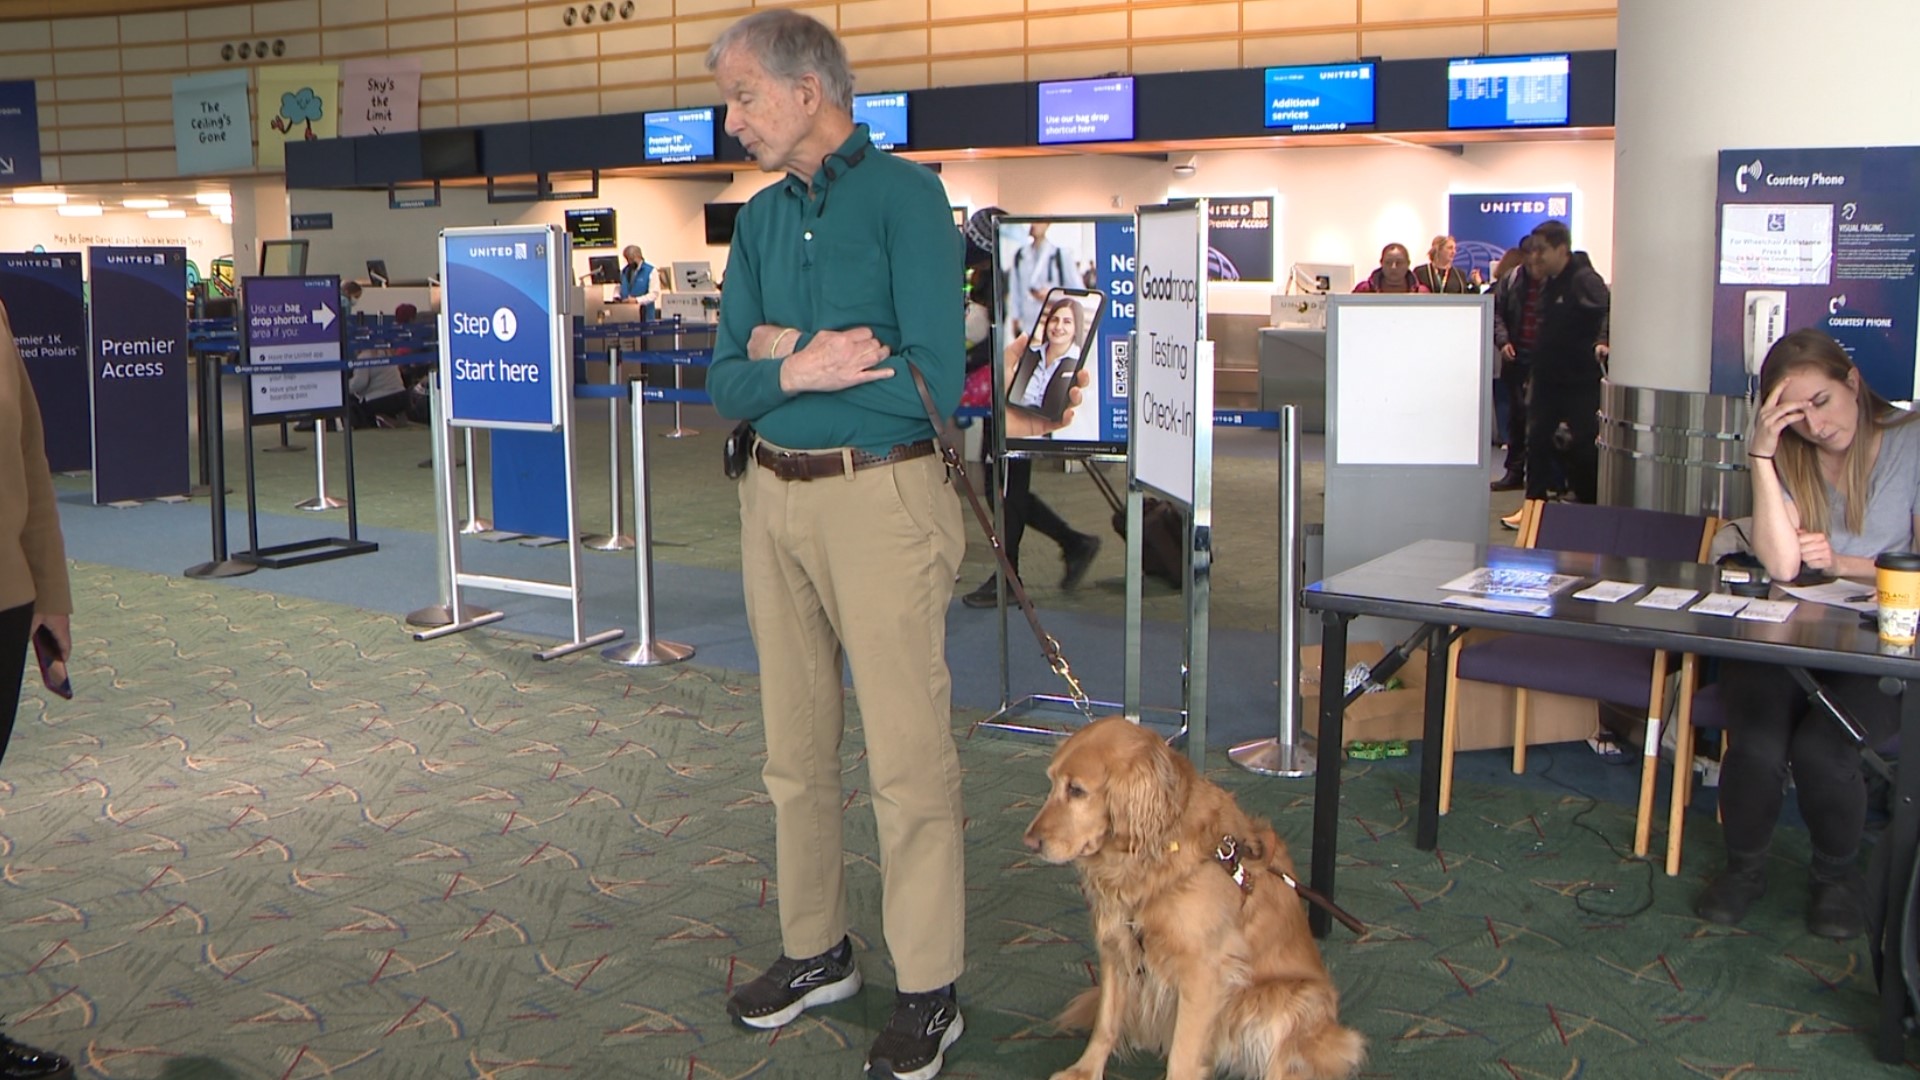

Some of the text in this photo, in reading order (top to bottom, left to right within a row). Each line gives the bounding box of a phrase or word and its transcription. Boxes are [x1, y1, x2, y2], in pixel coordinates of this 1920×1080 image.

[1320, 70, 1358, 79] UNITED
[367, 78, 394, 92] Sky's
[200, 101, 219, 113] The
[371, 96, 388, 107] the
[1272, 97, 1320, 109] Additional
[191, 113, 231, 130] Ceiling's
[366, 109, 392, 122] Limit
[1045, 113, 1110, 124] Use our bag drop
[1272, 110, 1309, 121] services
[1045, 125, 1096, 135] shortcut here
[199, 131, 227, 144] Gone
[1766, 172, 1845, 189] Courtesy Phone
[1208, 204, 1250, 216] NITED
[1480, 201, 1545, 213] UNITED
[1240, 218, 1269, 229] Access
[470, 247, 512, 258] UNITED
[8, 259, 49, 267] UNITED
[108, 255, 152, 264] UNITED
[1111, 254, 1135, 272] Ne
[251, 303, 301, 315] Use our bag
[1112, 300, 1135, 318] he
[251, 314, 308, 327] drop shortcut
[454, 313, 509, 338] Step 1
[1828, 317, 1892, 327] COURTESY PHONE
[252, 329, 271, 338] area
[274, 328, 279, 337] if
[14, 334, 43, 345] emier
[20, 347, 39, 358] ted
[101, 337, 175, 356] Premier
[1149, 332, 1188, 380] Testing
[102, 362, 164, 379] Access
[455, 359, 539, 383] Start here
[1143, 392, 1192, 437] Check-In
